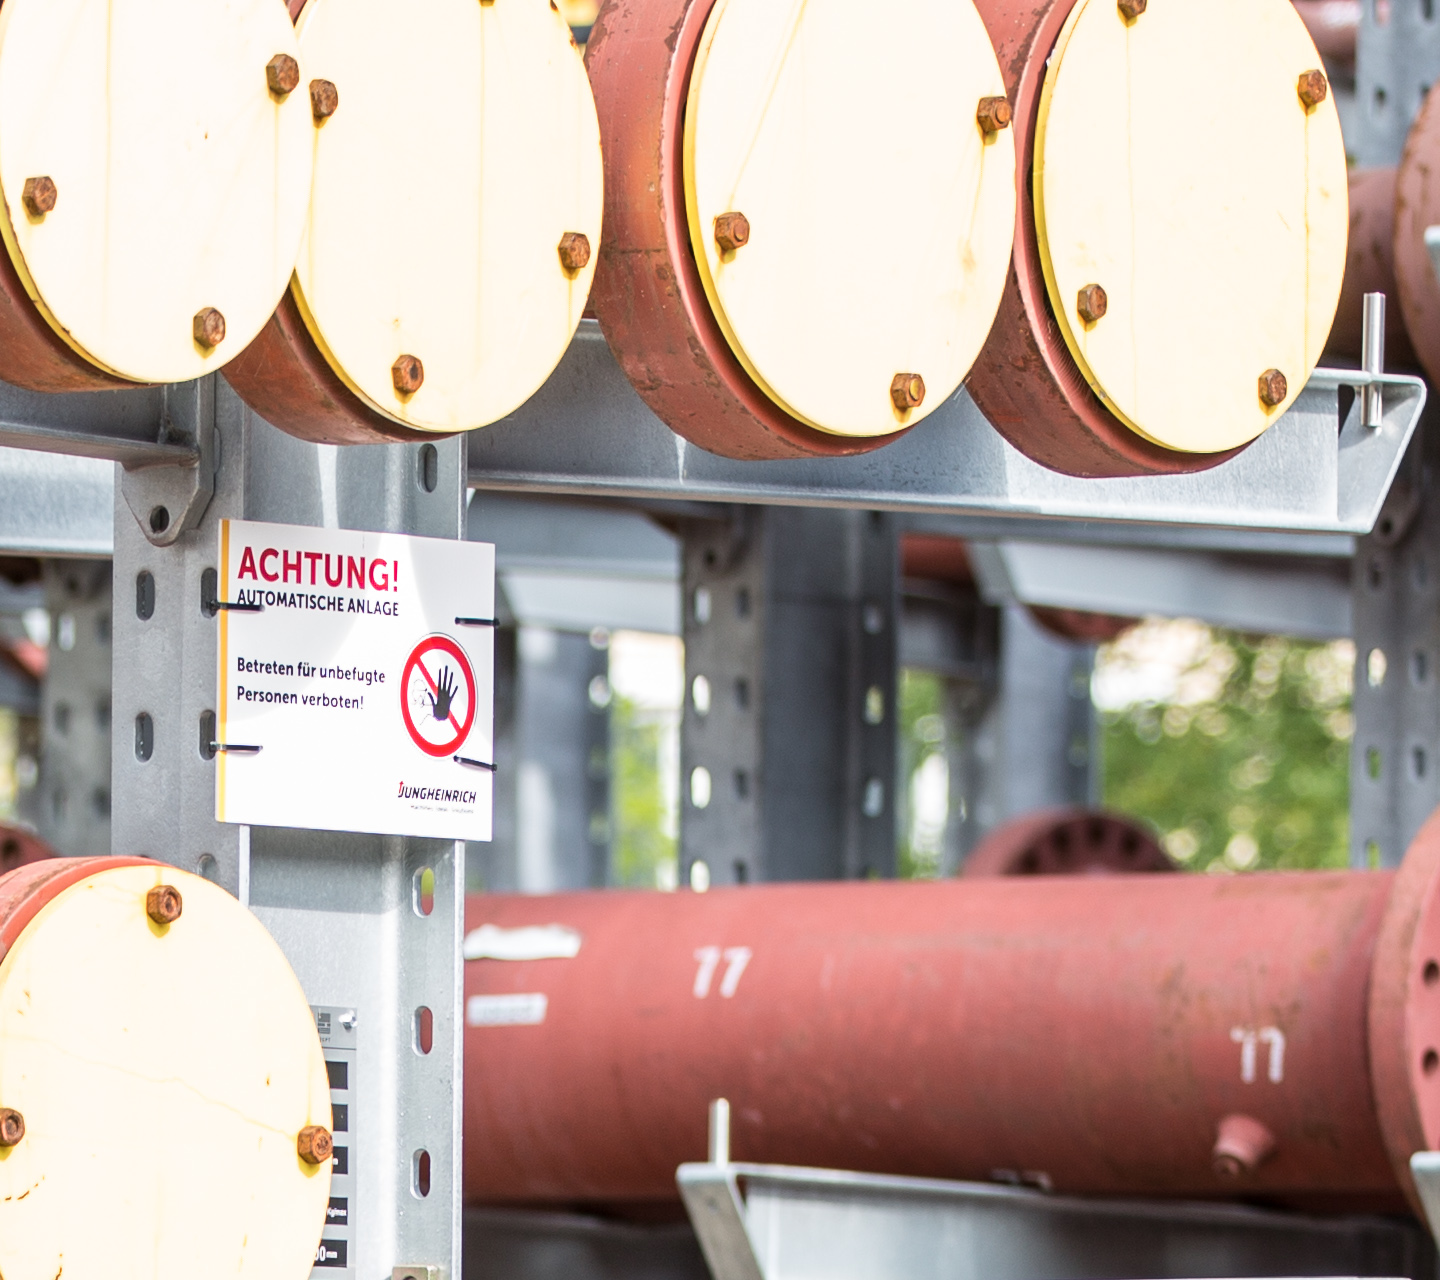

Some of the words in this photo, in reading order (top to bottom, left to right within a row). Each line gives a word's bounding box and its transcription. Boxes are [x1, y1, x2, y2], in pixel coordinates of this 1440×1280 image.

[237, 546, 399, 592] ACHTUNG!
[238, 589, 344, 612] AUTOMATISCHE
[347, 600, 399, 616] ANLAGE
[237, 657, 294, 677] Betreten
[297, 661, 316, 678] für
[320, 666, 386, 685] unbefugte
[237, 686, 298, 705] Personen
[301, 693, 364, 709] verboten!
[397, 783, 477, 804] JUNGHEINRICH
